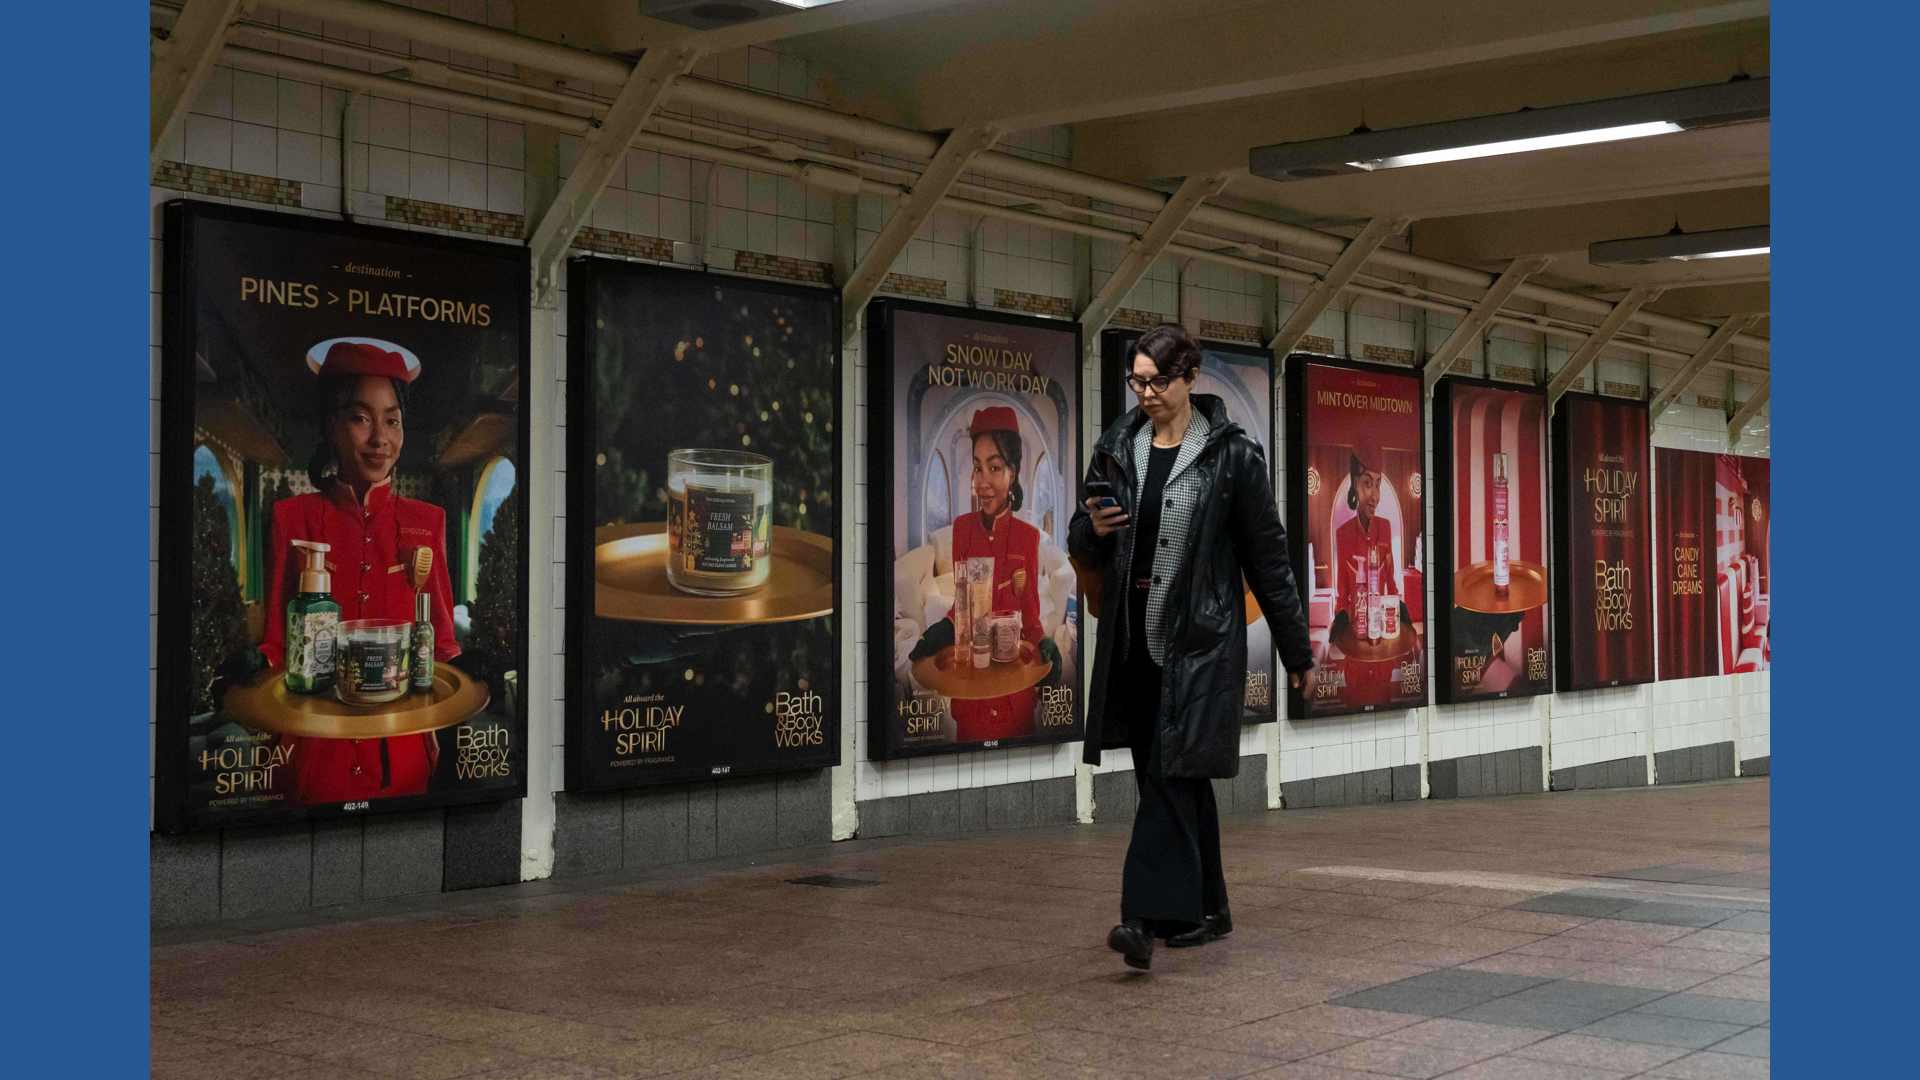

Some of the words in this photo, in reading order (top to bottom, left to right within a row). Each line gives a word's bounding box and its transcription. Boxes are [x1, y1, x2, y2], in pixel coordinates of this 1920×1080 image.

[344, 261, 401, 279] destination
[240, 276, 320, 309] PINES
[347, 289, 492, 327] PLATFORMS
[946, 343, 999, 367] SNOW
[1002, 350, 1032, 371] DAY
[928, 364, 965, 387] NOT
[967, 369, 1017, 392] WORK
[1020, 374, 1050, 395] DAY
[1316, 390, 1342, 407] MINT
[1343, 392, 1368, 409] OVER
[1369, 395, 1414, 414] MIDTOWN
[1583, 467, 1638, 495] HOLIDAY
[710, 512, 732, 521] FRESH
[1594, 493, 1630, 523] SPIRIT
[707, 521, 733, 531] BALSAM
[1674, 546, 1699, 561] CANDY
[1595, 560, 1632, 590] Bath
[1677, 563, 1698, 578] CANE
[1672, 579, 1703, 595] DREAMS
[1595, 607, 1633, 631] Works
[1400, 659, 1421, 674] Bath
[775, 690, 822, 716] Bath
[1042, 684, 1073, 704] Bath
[600, 705, 685, 732] HOLIDAY
[906, 711, 945, 734] SPIRIT
[1041, 711, 1073, 727] Works
[456, 723, 509, 749] Bath
[615, 725, 672, 755] SPIRIT
[774, 728, 824, 748] Works
[198, 743, 295, 771] HOLIDAY
[215, 764, 281, 794] SPIRIT
[455, 760, 511, 780] Works
